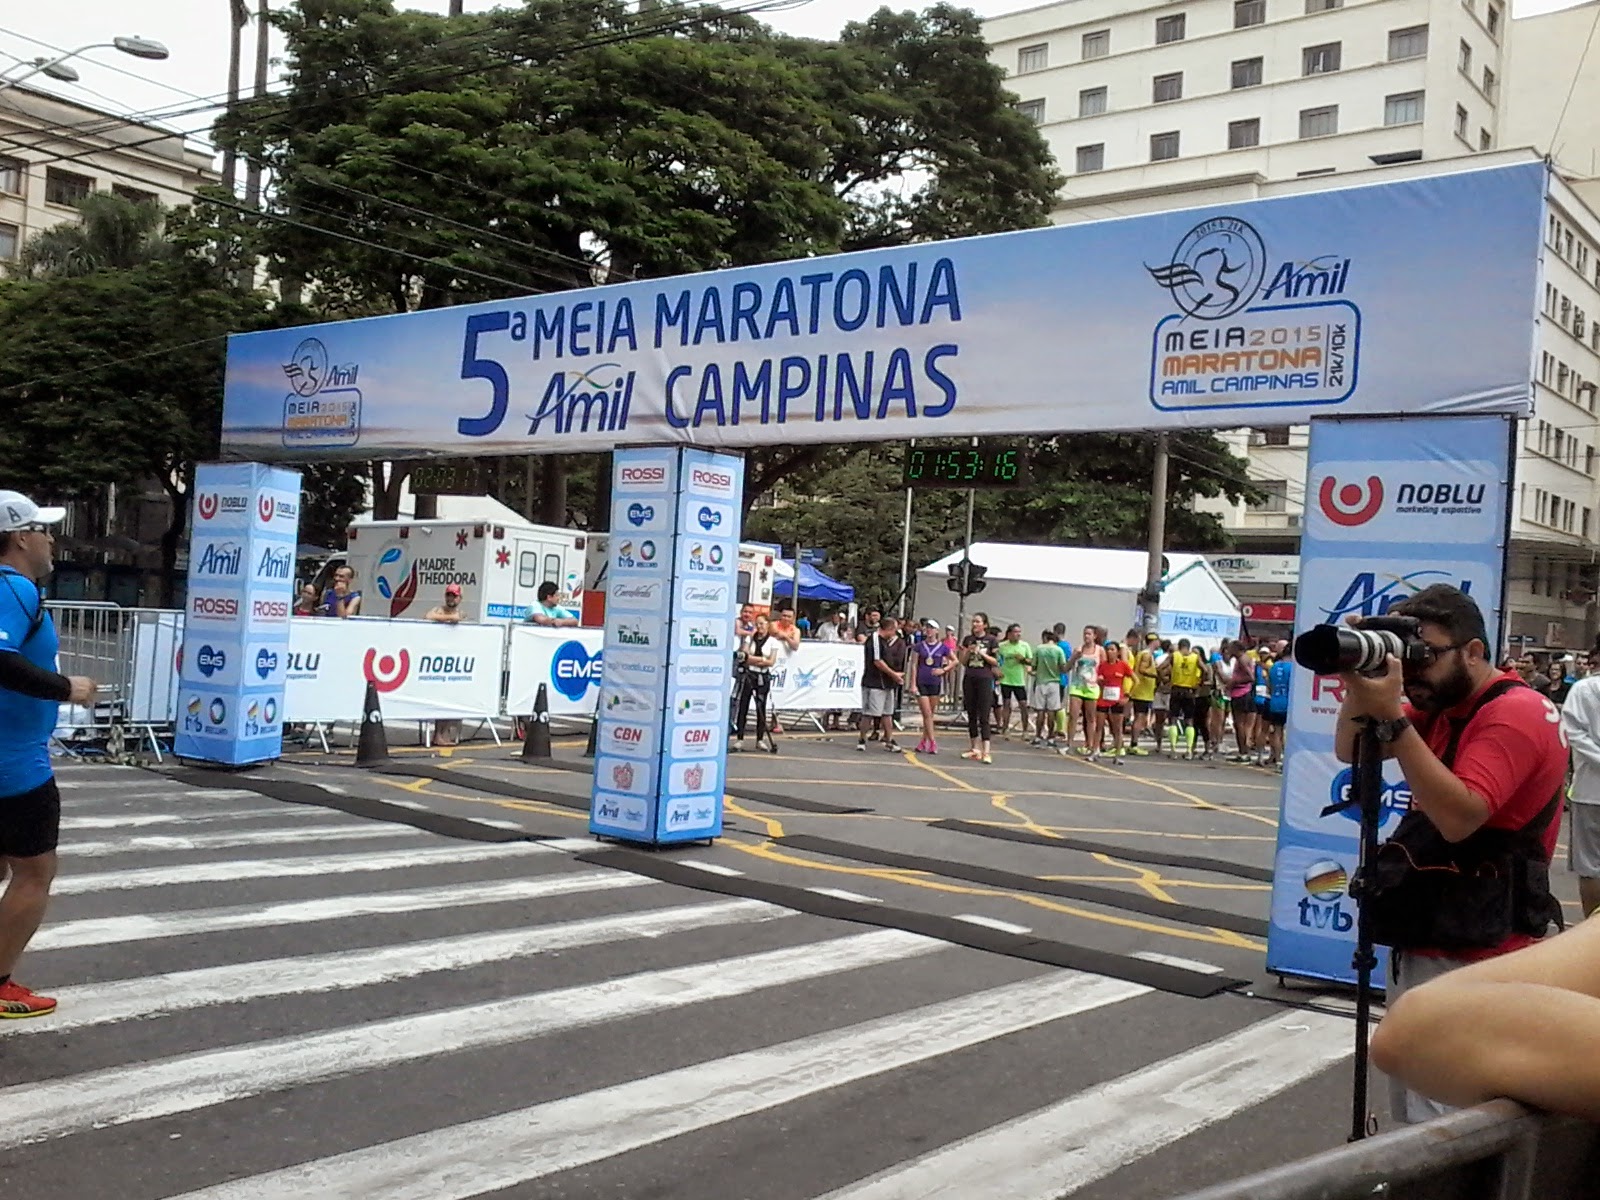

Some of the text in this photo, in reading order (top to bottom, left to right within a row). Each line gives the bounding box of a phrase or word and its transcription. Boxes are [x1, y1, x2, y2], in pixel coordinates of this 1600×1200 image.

[1261, 255, 1351, 300] Amil
[533, 298, 637, 360] MEIA
[654, 257, 961, 349] MARATONA
[1165, 326, 1321, 352] MEIA 2015
[1163, 347, 1321, 376] MARATONA
[326, 364, 359, 386] Amil
[1162, 372, 1319, 395] AMIL CAMPINAS
[525, 344, 959, 436] Amil CAMPINAS
[622, 468, 665, 480] ROSSI
[909, 451, 1017, 479] 01:53:16
[693, 470, 731, 486] ROSSI
[198, 543, 242, 575] Amil
[257, 547, 292, 579] Amil
[419, 558, 455, 571] MADRE
[418, 571, 476, 586] THEODORA
[193, 597, 239, 615] ROSSI
[253, 600, 288, 618] ROSSI
[1173, 613, 1194, 630] ÁREA
[1195, 615, 1218, 632] MÉDICA
[557, 659, 603, 678] EMS
[829, 668, 856, 688] Amil
[613, 727, 643, 742] CBN
[684, 729, 711, 743] CBN
[1298, 897, 1353, 932] tvb
